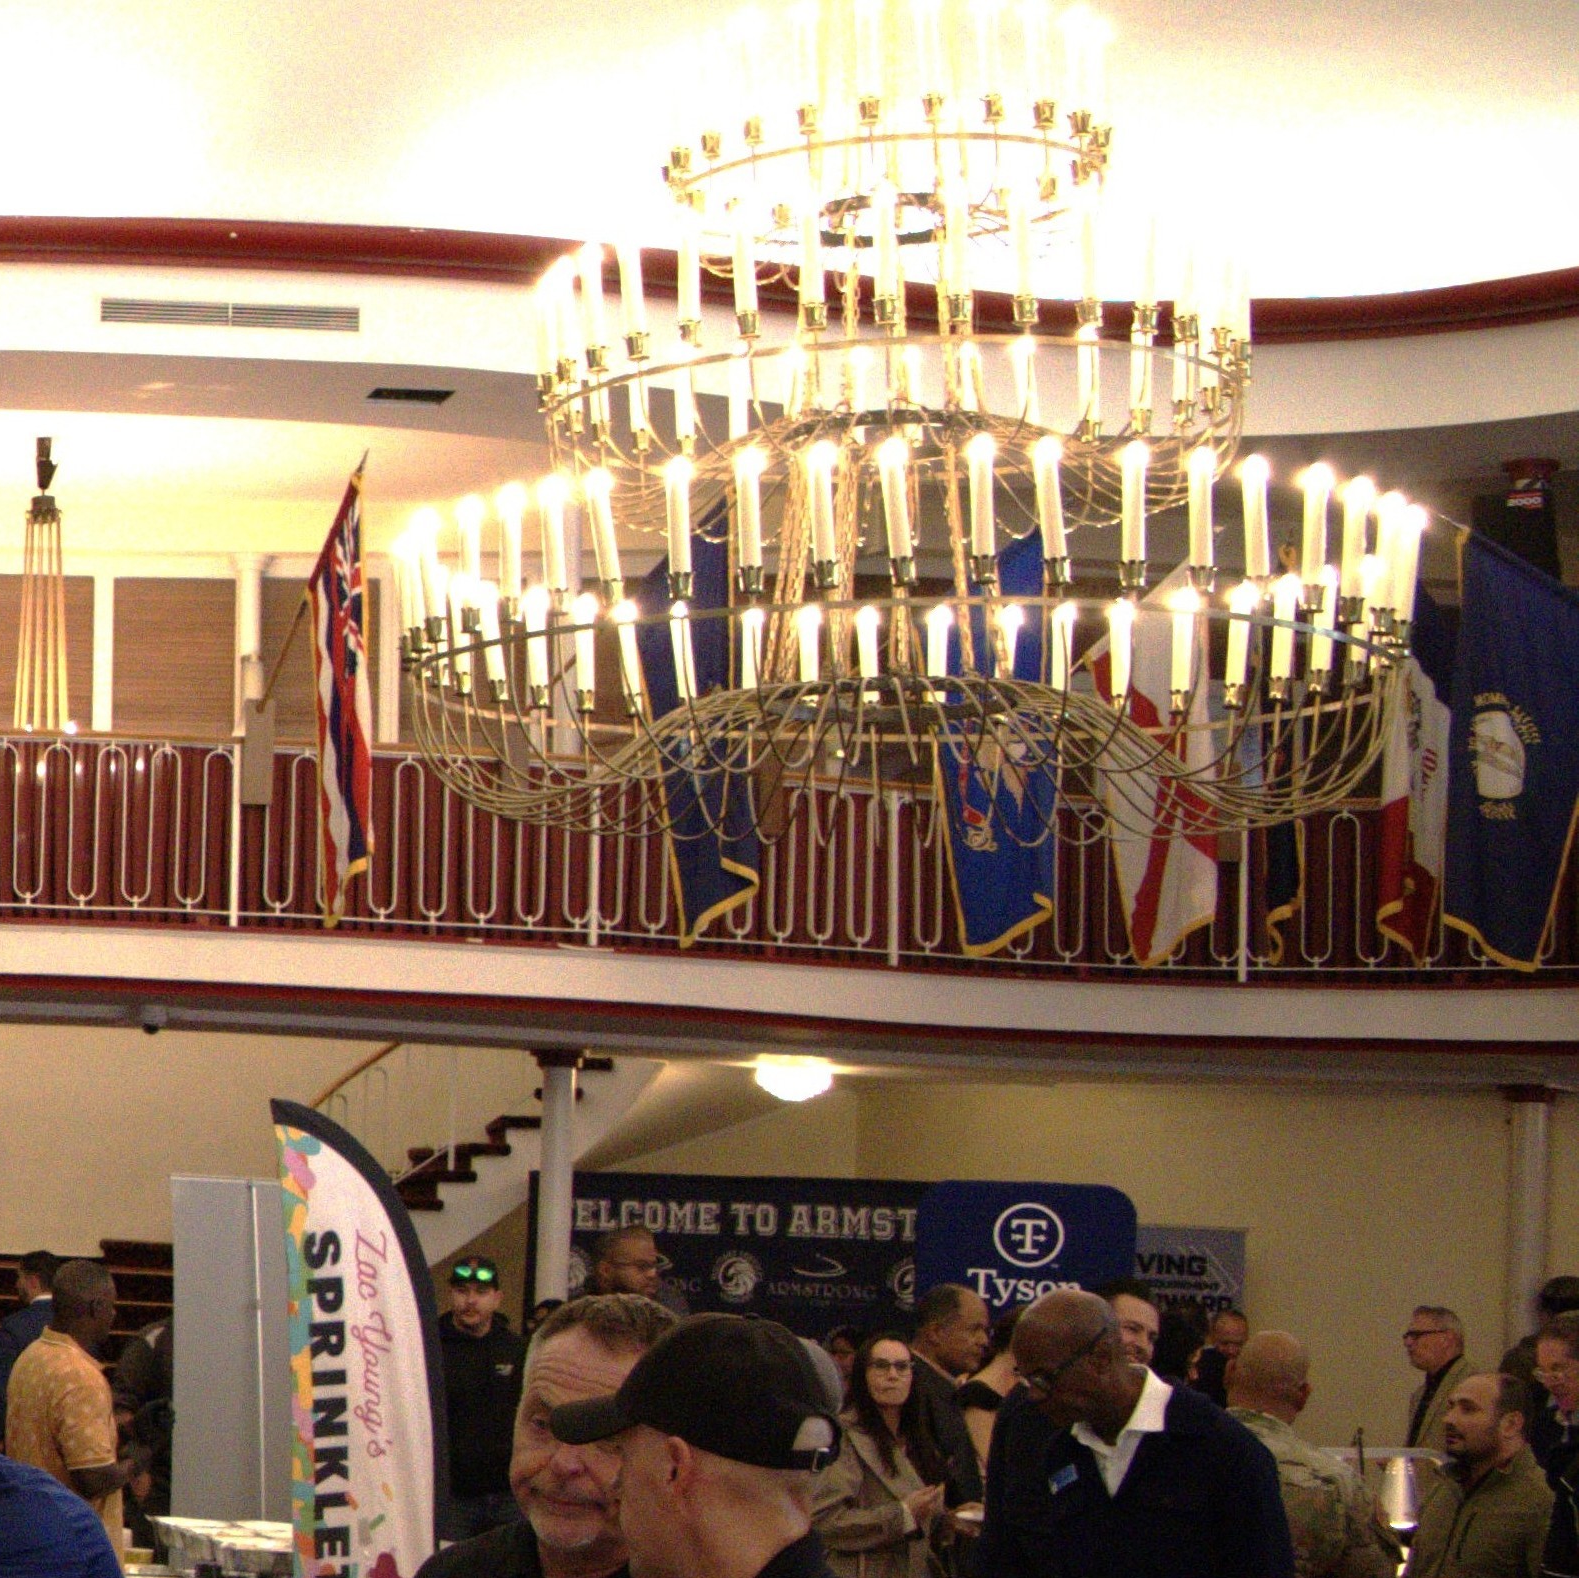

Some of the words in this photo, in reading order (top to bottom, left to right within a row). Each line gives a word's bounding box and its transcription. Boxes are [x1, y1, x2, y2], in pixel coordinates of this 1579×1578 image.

[574, 1198, 721, 1235] ELCOME
[731, 1203, 778, 1237] TO
[787, 1204, 917, 1242] ARMST
[354, 1229, 388, 1300] Zac
[1138, 1252, 1208, 1277] VING
[350, 1310, 393, 1458] Young's
